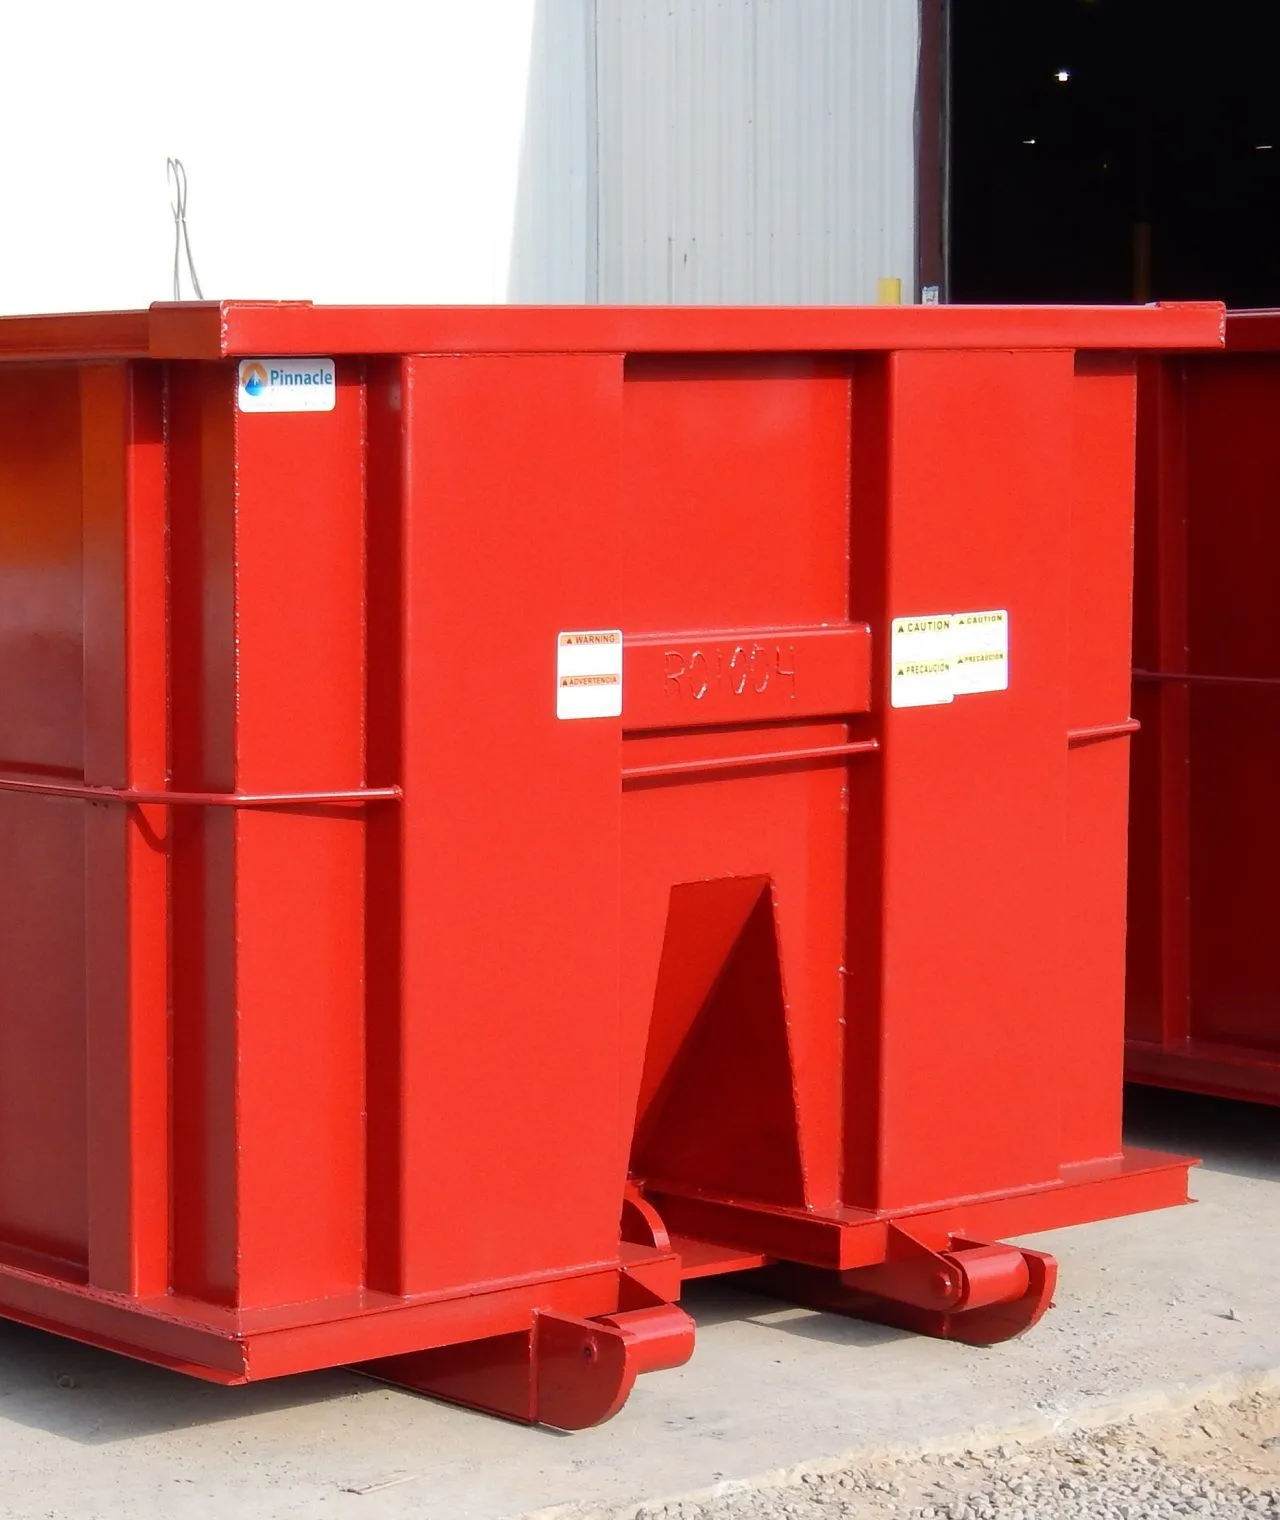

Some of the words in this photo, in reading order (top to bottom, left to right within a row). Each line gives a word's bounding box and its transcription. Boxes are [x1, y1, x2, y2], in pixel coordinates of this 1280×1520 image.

[270, 369, 333, 385] Pinnacle
[966, 615, 1003, 625] CAUTION
[907, 620, 950, 632] CAUTION
[575, 634, 616, 644] WARNING
[569, 676, 617, 686] ADVERTENCIA
